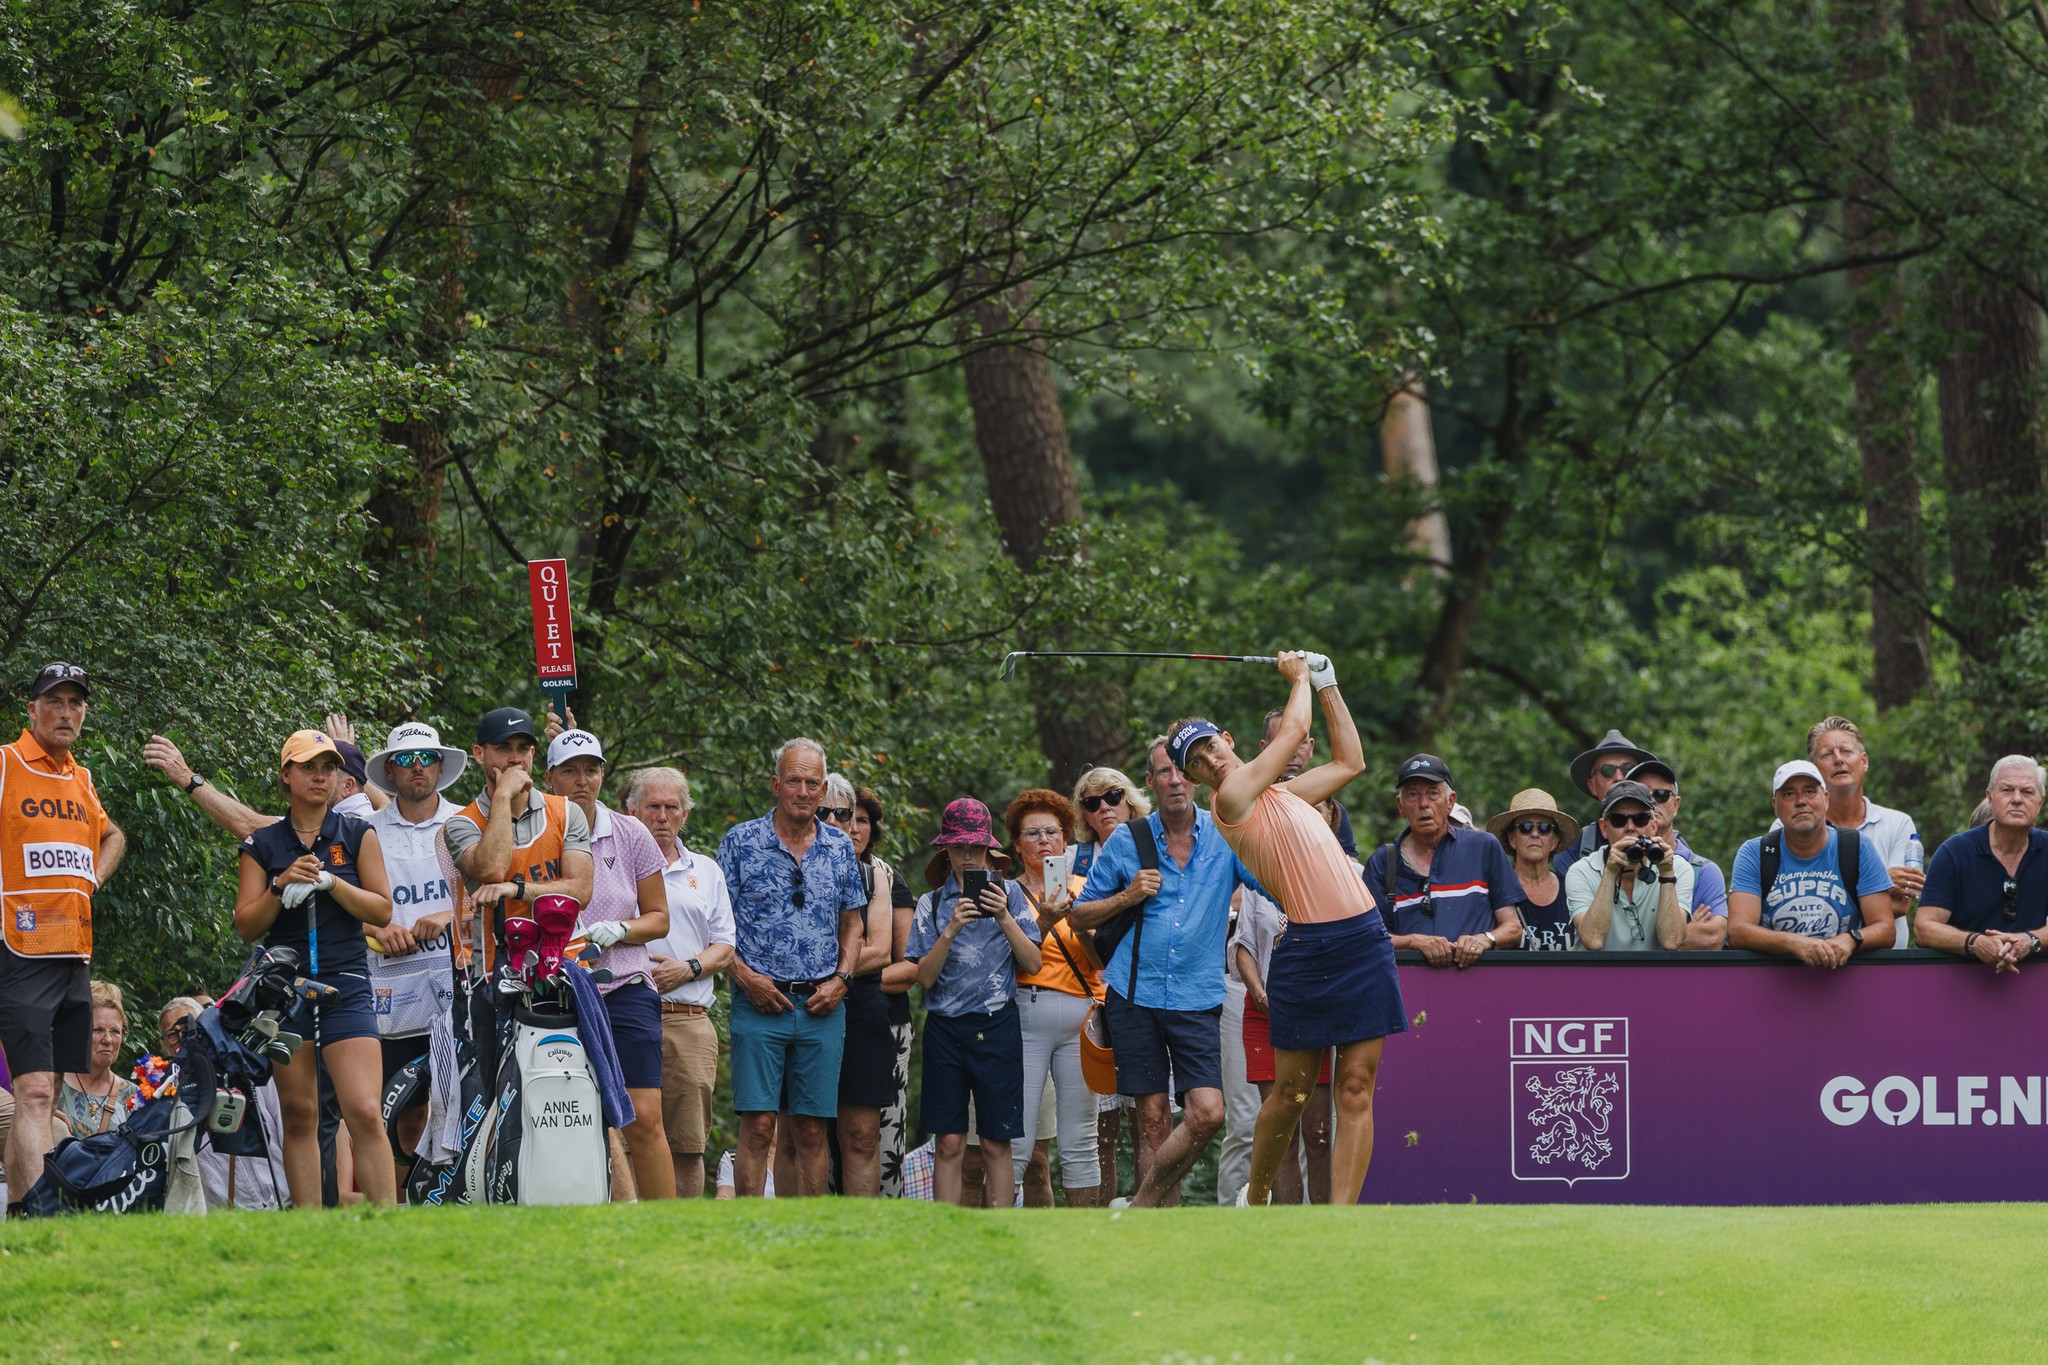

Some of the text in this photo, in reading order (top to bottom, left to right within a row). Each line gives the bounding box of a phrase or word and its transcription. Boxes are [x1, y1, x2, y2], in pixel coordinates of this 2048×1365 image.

[540, 566, 562, 659] QUIET
[541, 664, 572, 673] PLEASE
[542, 679, 574, 688] GOLF.NL
[562, 733, 593, 746] Callaway
[21, 798, 89, 825] GOLF.NL
[29, 850, 81, 870] BOERE
[392, 878, 453, 905] OLF.N
[1766, 879, 1847, 907] SUPER
[1789, 904, 1823, 912] AUTO
[437, 989, 453, 1000] #g
[1524, 1023, 1614, 1054] NGF
[547, 1048, 573, 1058] Callaway
[543, 1101, 579, 1114] ANNE
[1820, 1075, 2048, 1126] GOLF.N
[531, 1114, 593, 1129] VAN DAM
